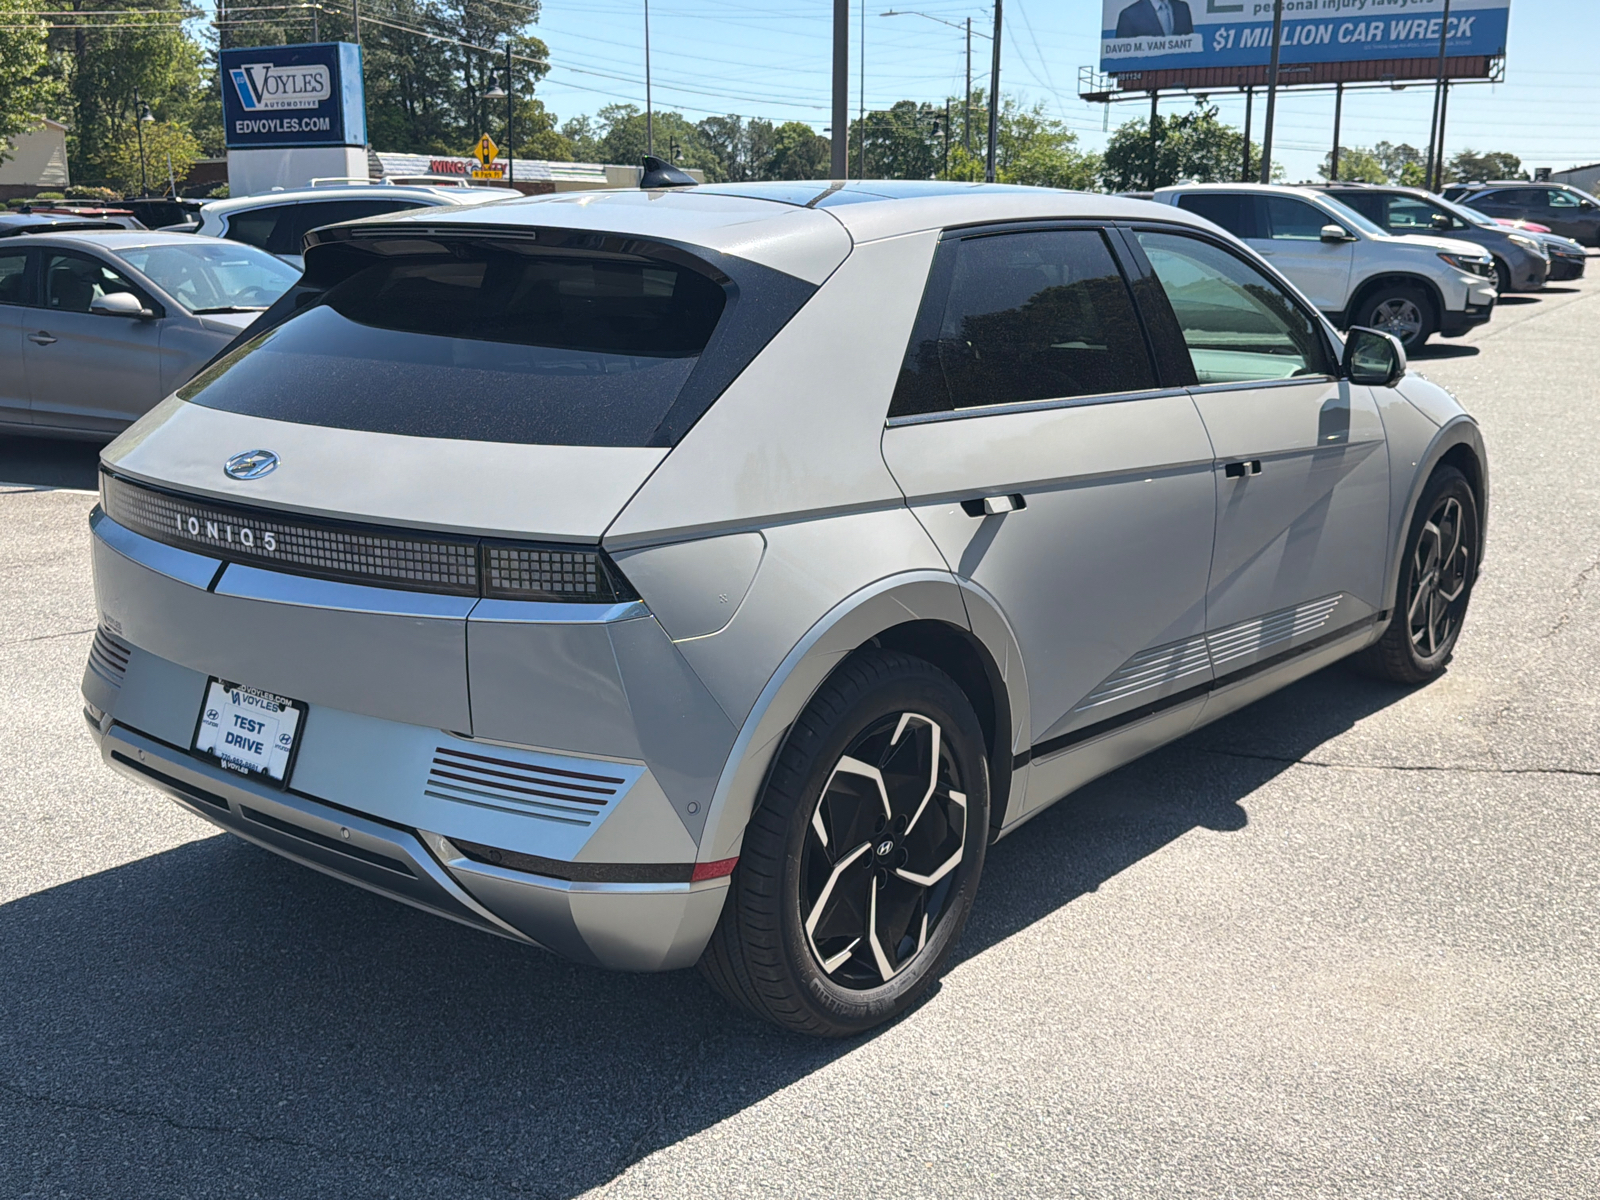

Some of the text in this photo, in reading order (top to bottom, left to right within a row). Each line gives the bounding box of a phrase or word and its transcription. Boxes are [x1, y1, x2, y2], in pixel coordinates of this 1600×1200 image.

[1213, 27, 1236, 51] $1
[1337, 22, 1385, 43] CAR
[1389, 16, 1476, 40] WRECK
[1105, 39, 1193, 54] DAVID M. VAN SANT
[264, 100, 317, 108] AUTOMOTIVE
[235, 117, 330, 133] EDVOYLES.COM
[431, 160, 465, 174] WING
[177, 513, 276, 551] IONIQ 5
[242, 693, 279, 713] VOYLES
[233, 714, 266, 735] TEST
[225, 731, 264, 755] DRIVE
